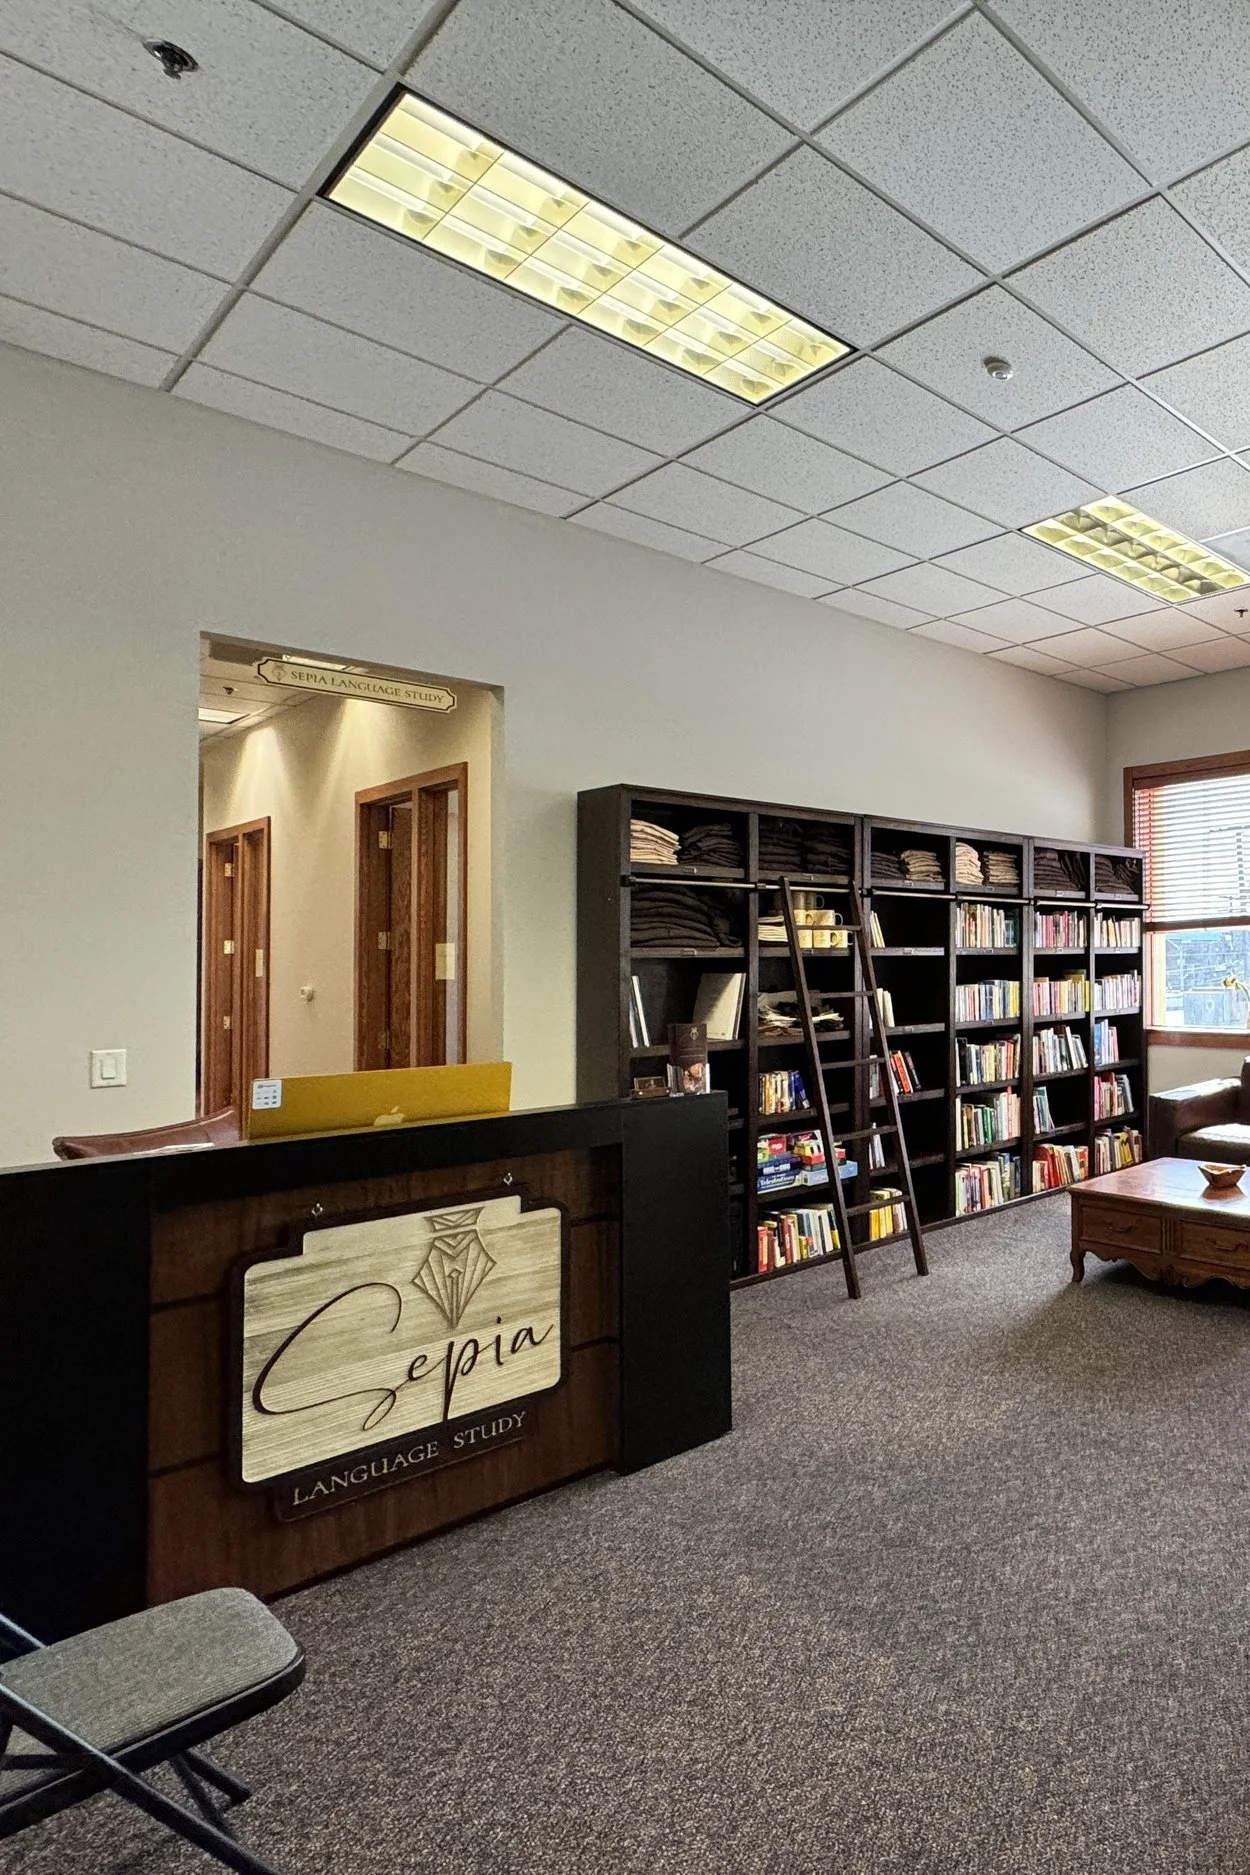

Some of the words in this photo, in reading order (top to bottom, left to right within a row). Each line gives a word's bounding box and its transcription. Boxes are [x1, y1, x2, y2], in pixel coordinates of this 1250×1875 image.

[291, 671, 327, 685] SEPIA
[331, 678, 401, 697] LANGUAGE
[404, 690, 445, 704] STUDY
[252, 1282, 555, 1432] Sepia
[292, 1441, 439, 1506] LANGUAGE
[453, 1411, 527, 1449] STUDY
